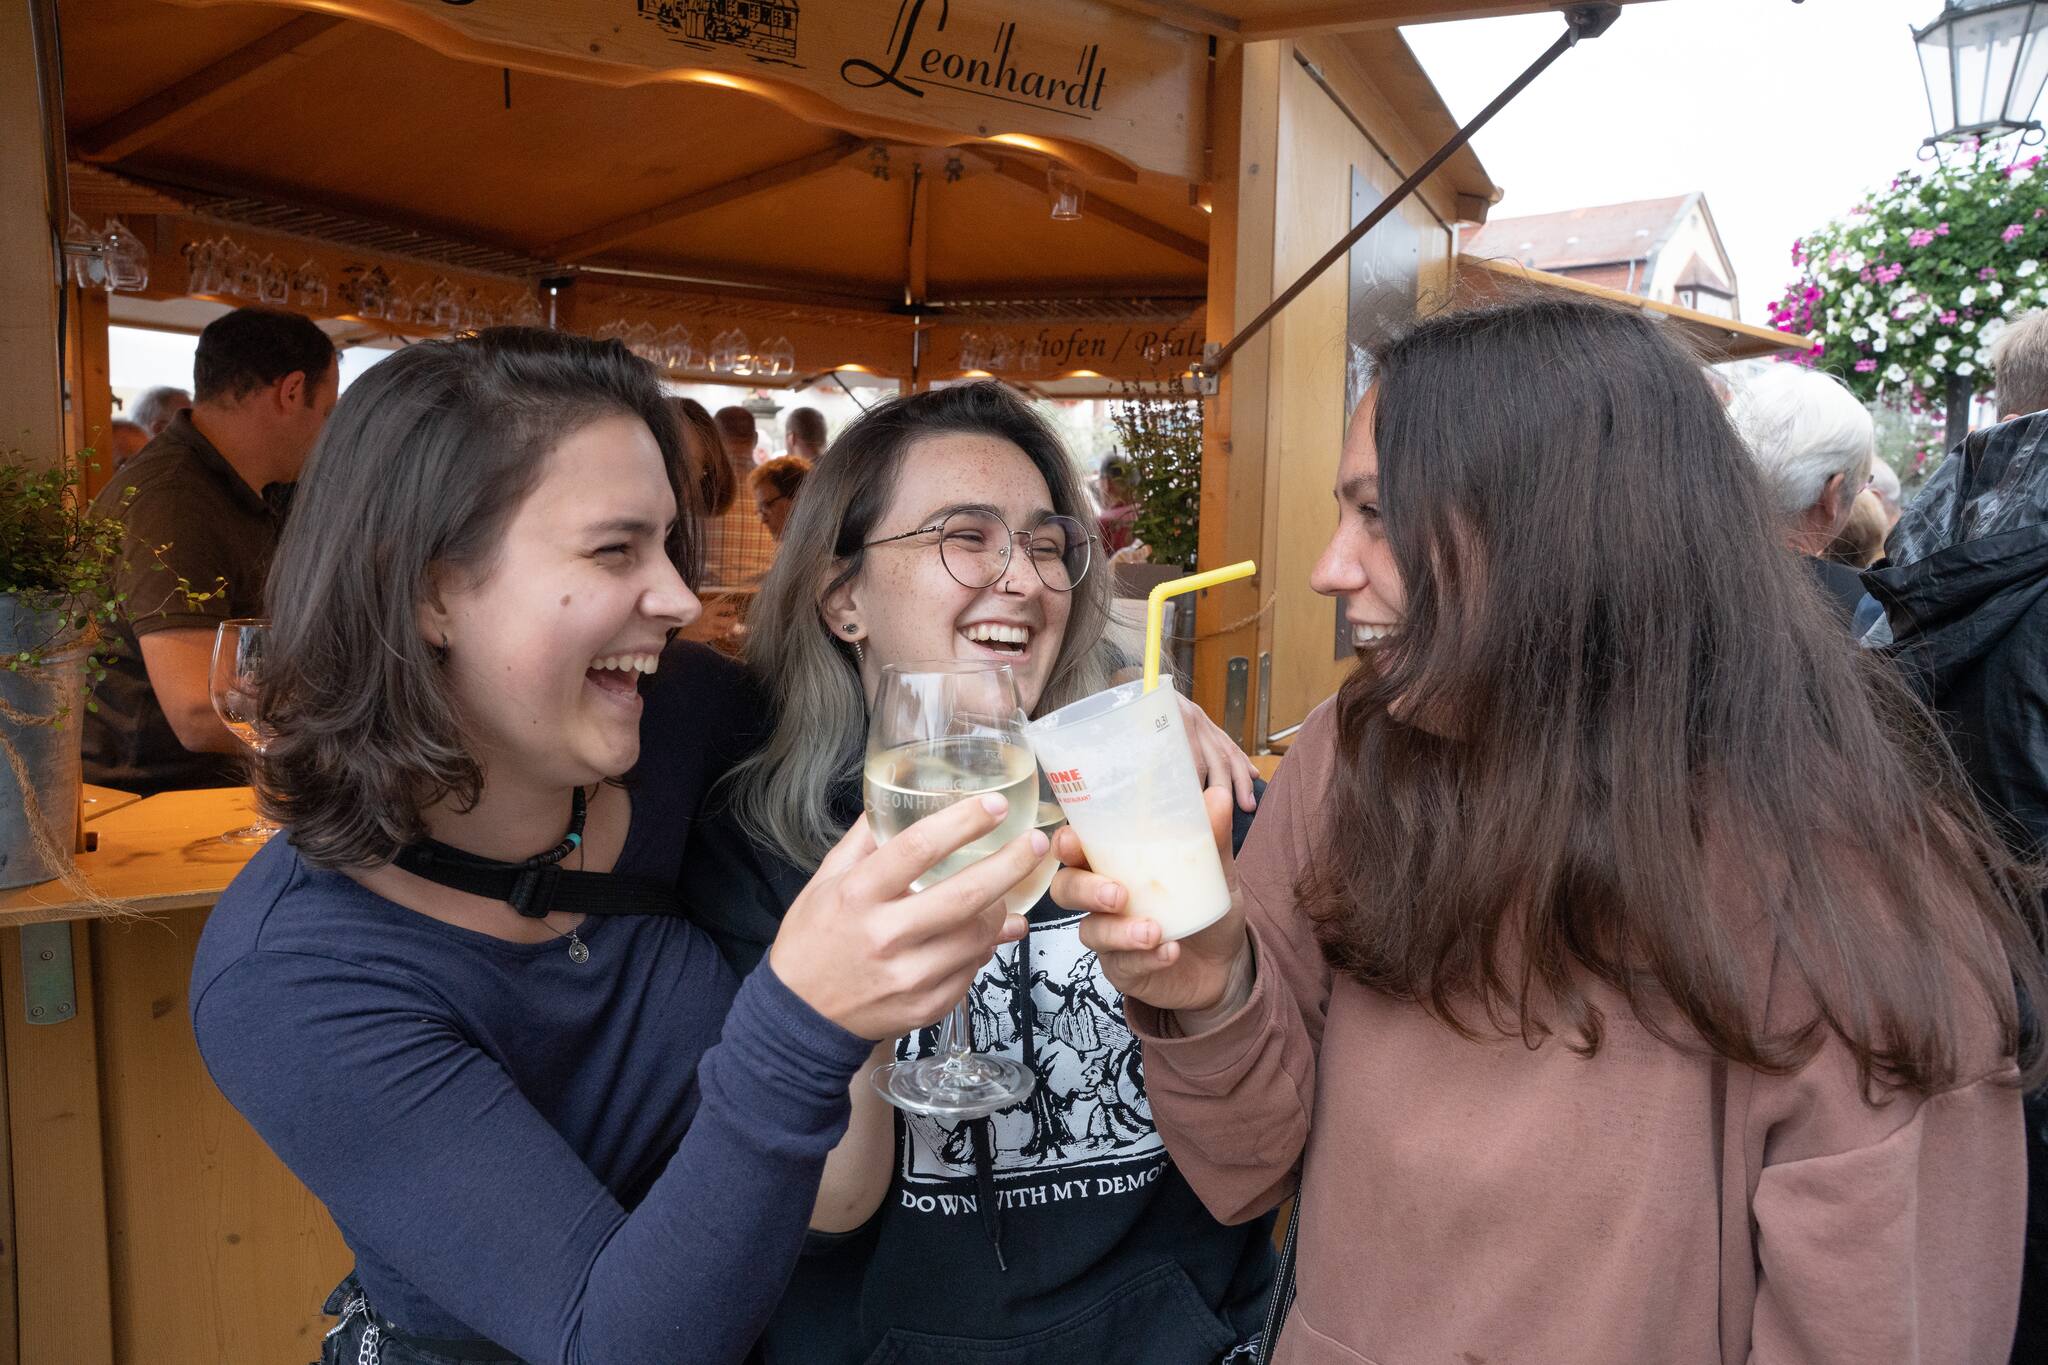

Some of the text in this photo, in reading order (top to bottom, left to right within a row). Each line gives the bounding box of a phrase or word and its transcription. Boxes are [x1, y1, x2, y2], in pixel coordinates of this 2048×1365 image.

[840, 0, 1107, 111] Leonhardt
[901, 1189, 979, 1216] DOWN
[1053, 1178, 1091, 1201] MY
